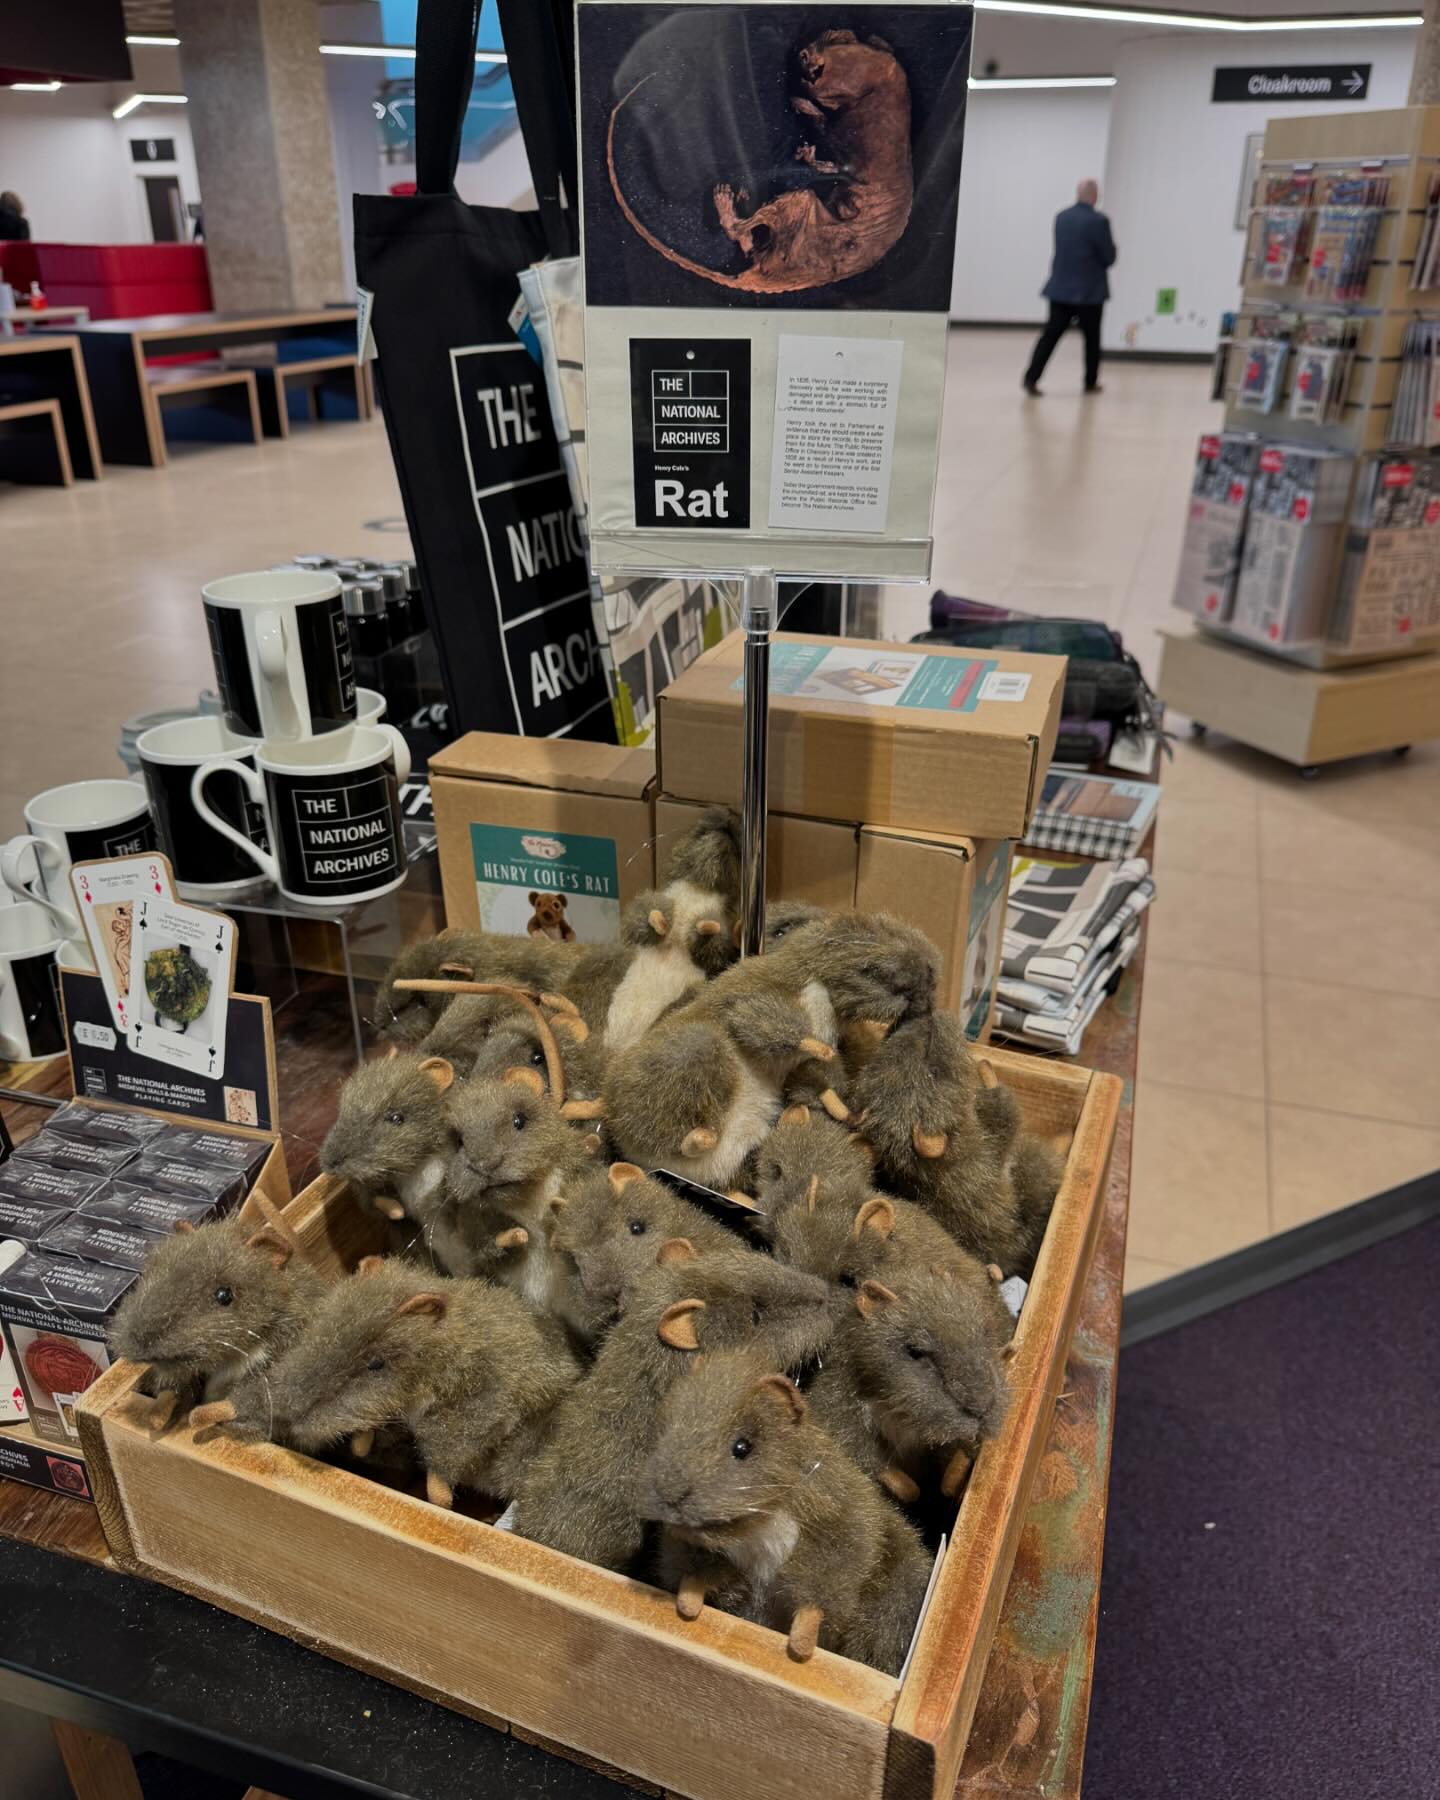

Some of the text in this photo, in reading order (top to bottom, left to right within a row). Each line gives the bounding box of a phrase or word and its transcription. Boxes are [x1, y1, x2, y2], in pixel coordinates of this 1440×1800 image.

[1247, 73, 1332, 95] Cloakroom
[659, 378, 683, 391] THE
[477, 384, 542, 450] THE
[661, 405, 721, 419] NATIONAL
[661, 432, 721, 445] ARCHIVES
[654, 465, 671, 473] Henry
[654, 479, 729, 518] Rat
[303, 798, 338, 814] THE
[309, 819, 386, 844] NATIONAL
[114, 838, 142, 857] THE
[313, 848, 389, 875] ARCHIVES
[150, 865, 159, 880] 3
[483, 862, 528, 883] HENRY
[534, 869, 579, 889] COLE'S
[585, 875, 610, 894] RAT
[80, 875, 89, 889] 3
[140, 902, 147, 916] J
[216, 925, 224, 939] J
[117, 1074, 206, 1096] THE NATIONAL ARCHIVES
[0, 1304, 105, 1332] THE NATIONAL ARCHIVES
[1, 1312, 34, 1324] MEDIEVAL
[35, 1319, 56, 1329] SEALS
